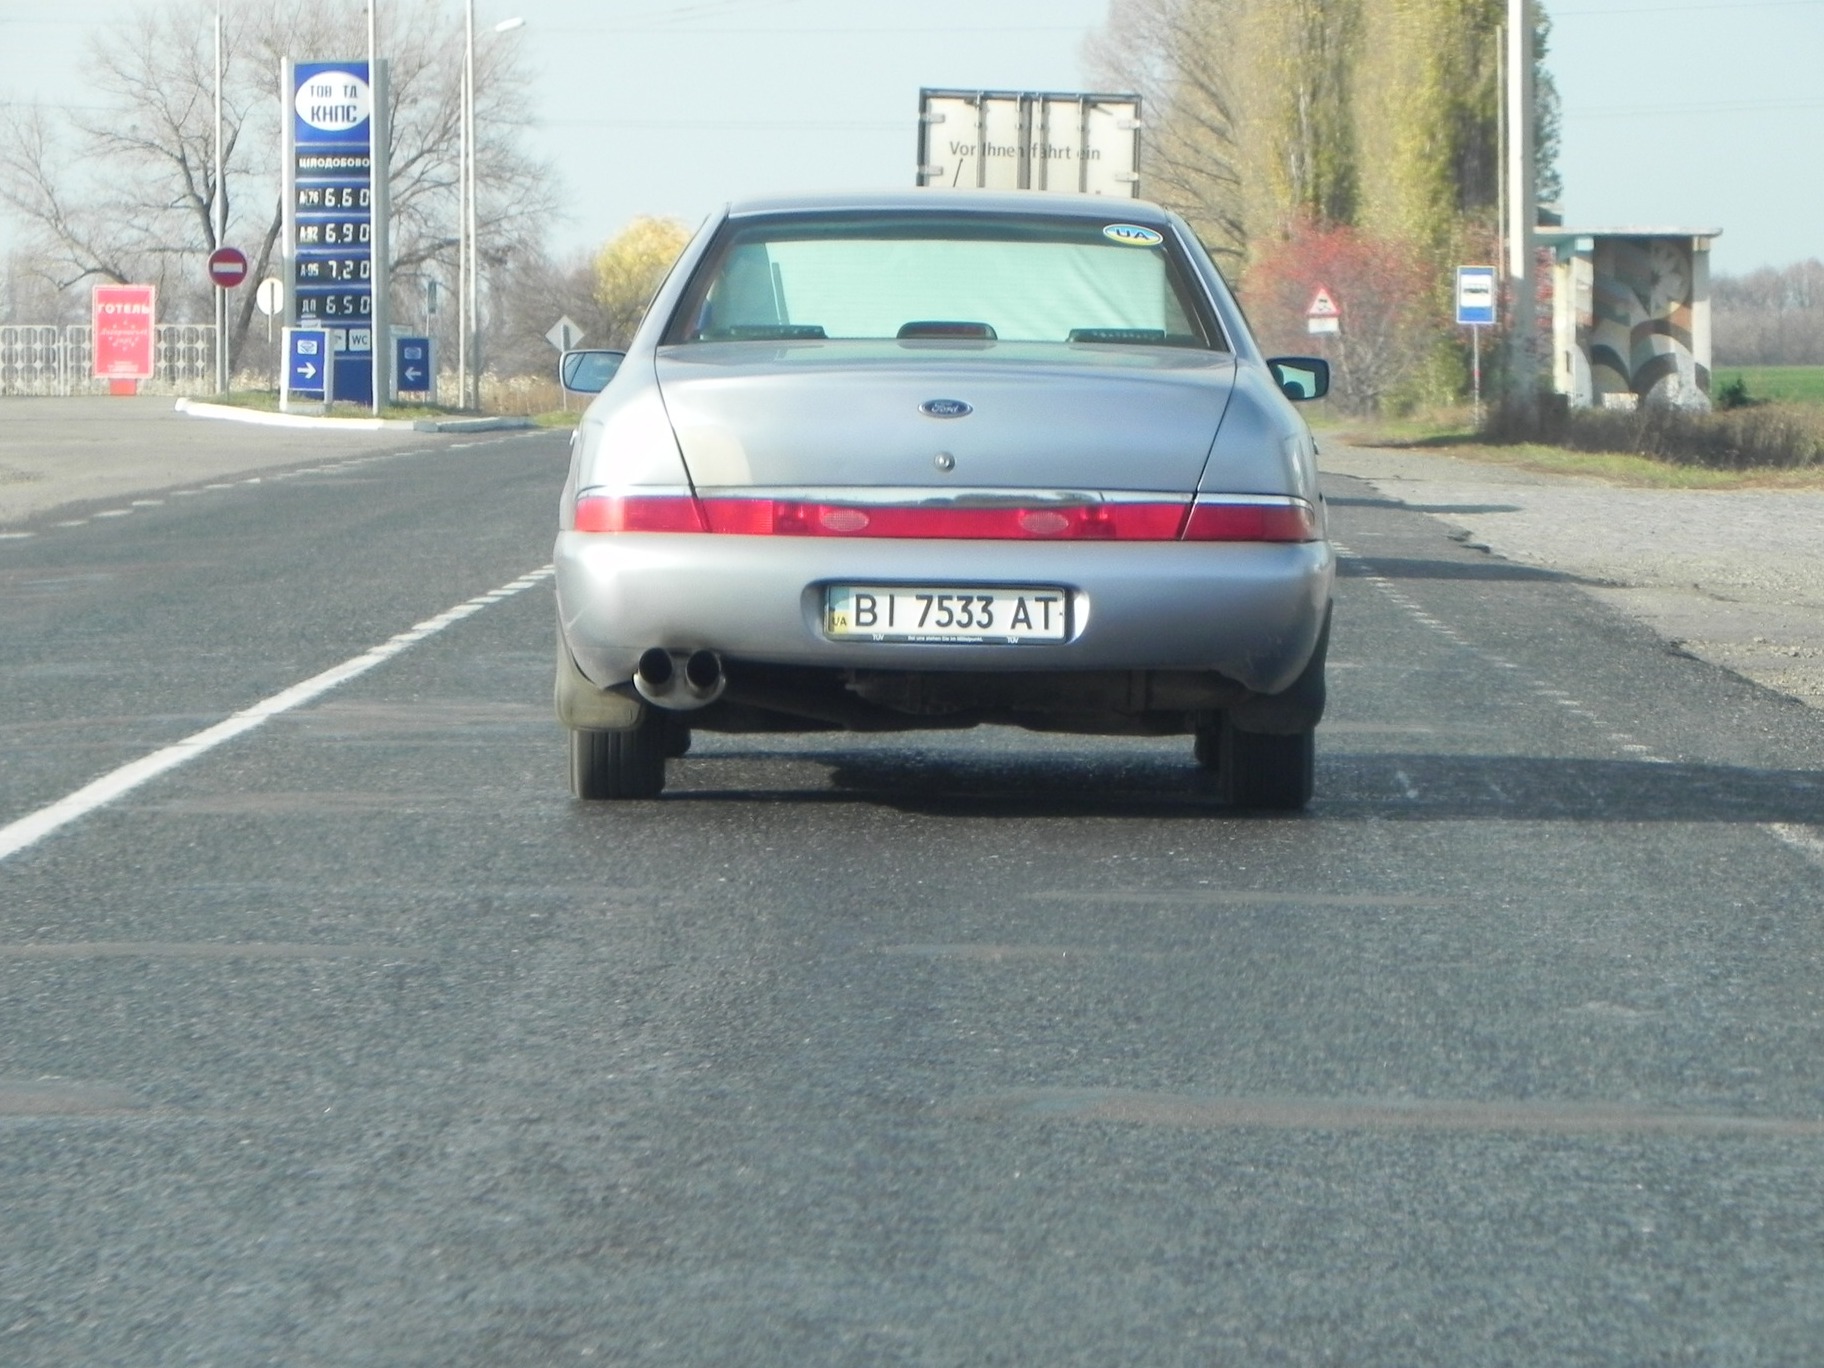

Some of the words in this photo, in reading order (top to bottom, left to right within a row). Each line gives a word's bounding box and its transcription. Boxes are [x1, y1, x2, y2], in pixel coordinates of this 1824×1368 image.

[311, 105, 357, 123] КНПС
[949, 141, 976, 156] Vor
[325, 223, 369, 244] 6.90
[1116, 229, 1149, 240] UA
[328, 260, 369, 280] 7.20
[98, 304, 150, 314] ГОТЕЛЬ
[326, 295, 370, 315] 6.50
[352, 334, 368, 345] WC
[855, 594, 894, 627] BI
[915, 595, 994, 629] 7533
[1010, 597, 1058, 630] AT
[832, 616, 847, 626] UA
